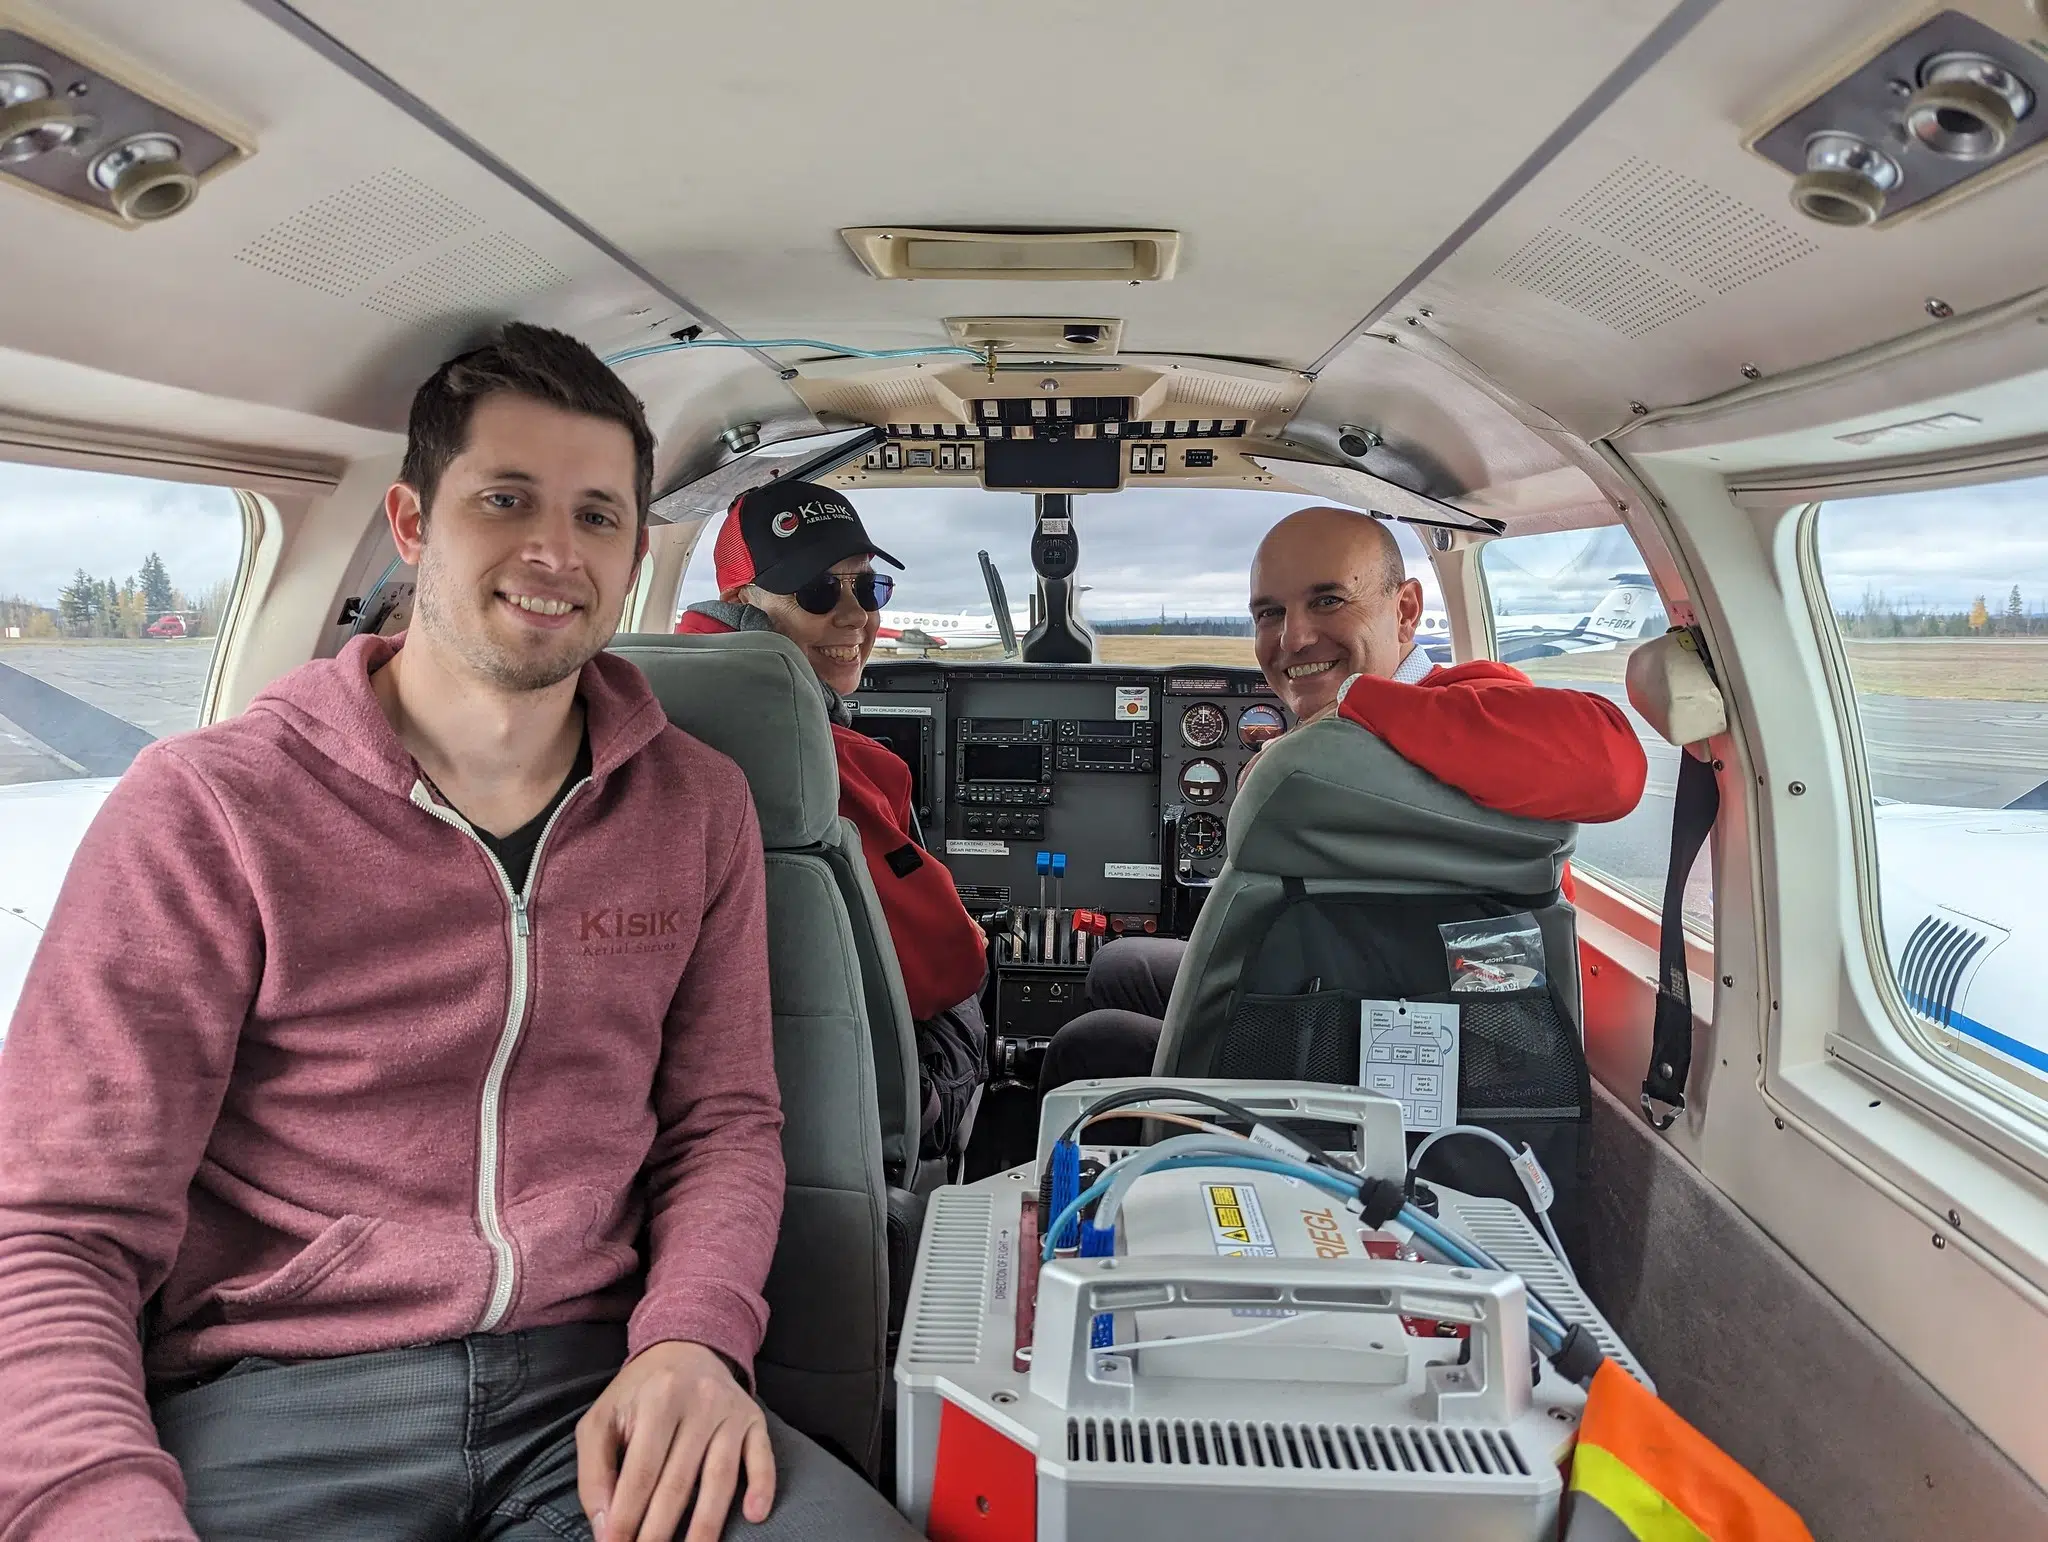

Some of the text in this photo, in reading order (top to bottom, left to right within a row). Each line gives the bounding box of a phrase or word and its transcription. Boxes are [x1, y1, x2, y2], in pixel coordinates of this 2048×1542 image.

[806, 514, 854, 524] AERIAL SURVEY
[1300, 1207, 1349, 1259] RIEGL
[995, 1240, 1008, 1299] DIRECTION OF FLIGHT
